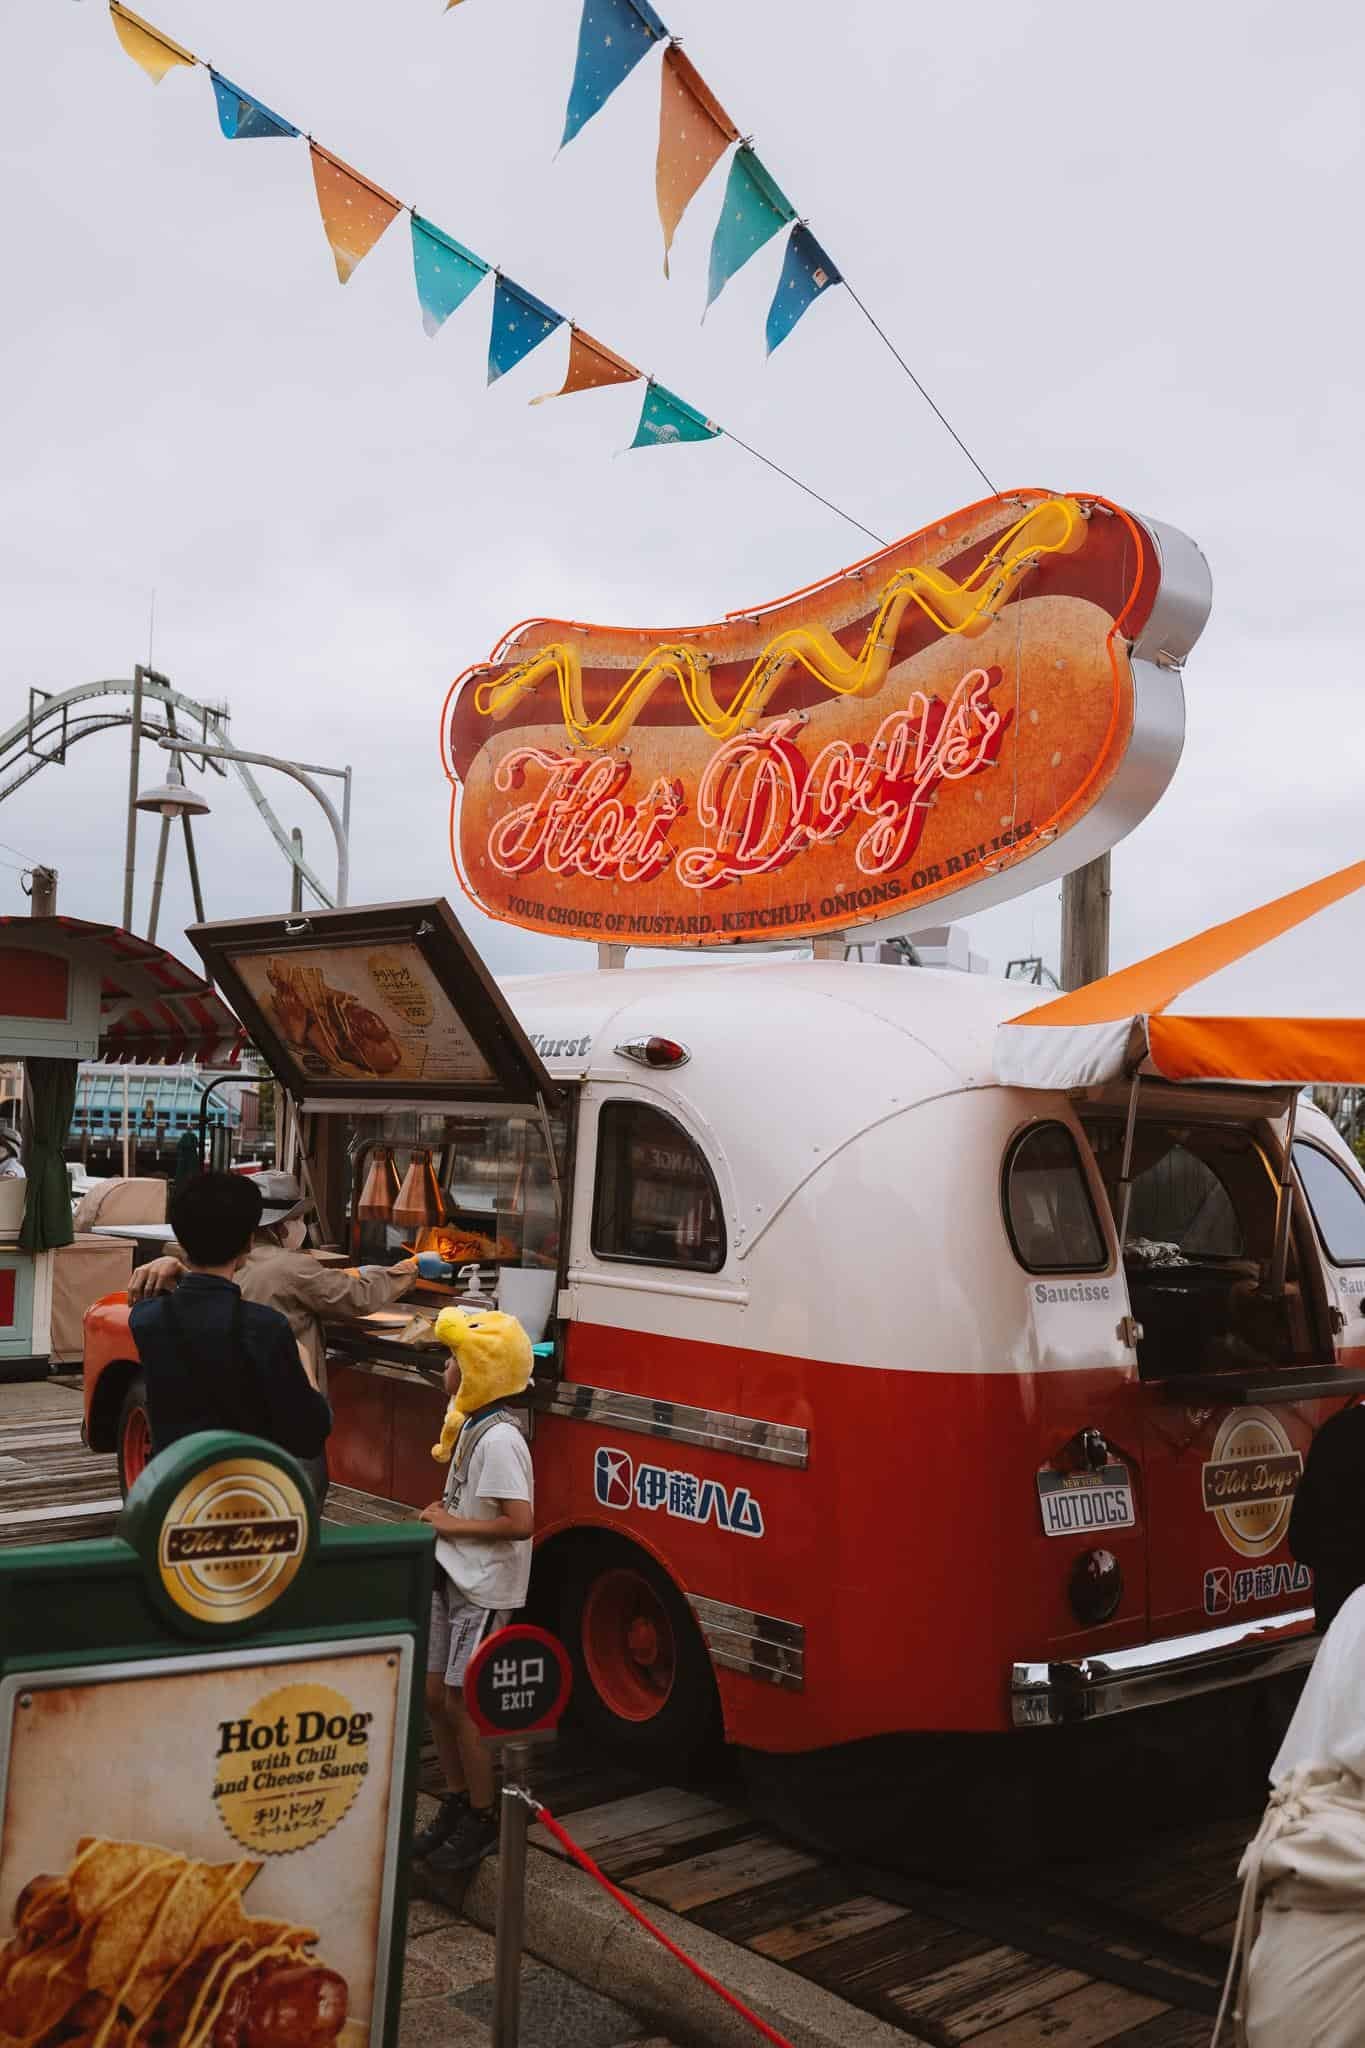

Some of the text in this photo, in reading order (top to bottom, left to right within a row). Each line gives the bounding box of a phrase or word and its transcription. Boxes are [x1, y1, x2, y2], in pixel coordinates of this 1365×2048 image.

[488, 667, 1011, 890] Hot Dogs
[507, 895, 544, 920] YOUR
[547, 906, 601, 929] CHOICE
[605, 914, 626, 931] OF
[722, 903, 816, 930] KETCHUP,
[911, 866, 943, 889] OR
[946, 820, 1033, 874] RELISH
[1034, 1282, 1110, 1303] Saucisse
[1214, 1463, 1295, 1497] Hot Dogs
[634, 1463, 765, 1538] 伊藤ハム
[1046, 1490, 1128, 1529] HOTDOGS
[181, 1526, 287, 1554] Hot Dogs
[1234, 1561, 1311, 1603] 伊藤ハム
[493, 1658, 543, 1688] 出口
[502, 1690, 535, 1710] EXIT
[216, 1711, 373, 1758] Hot Dog
[251, 1744, 337, 1772] with Chili
[212, 1760, 368, 1800] and Cheese Sauce
